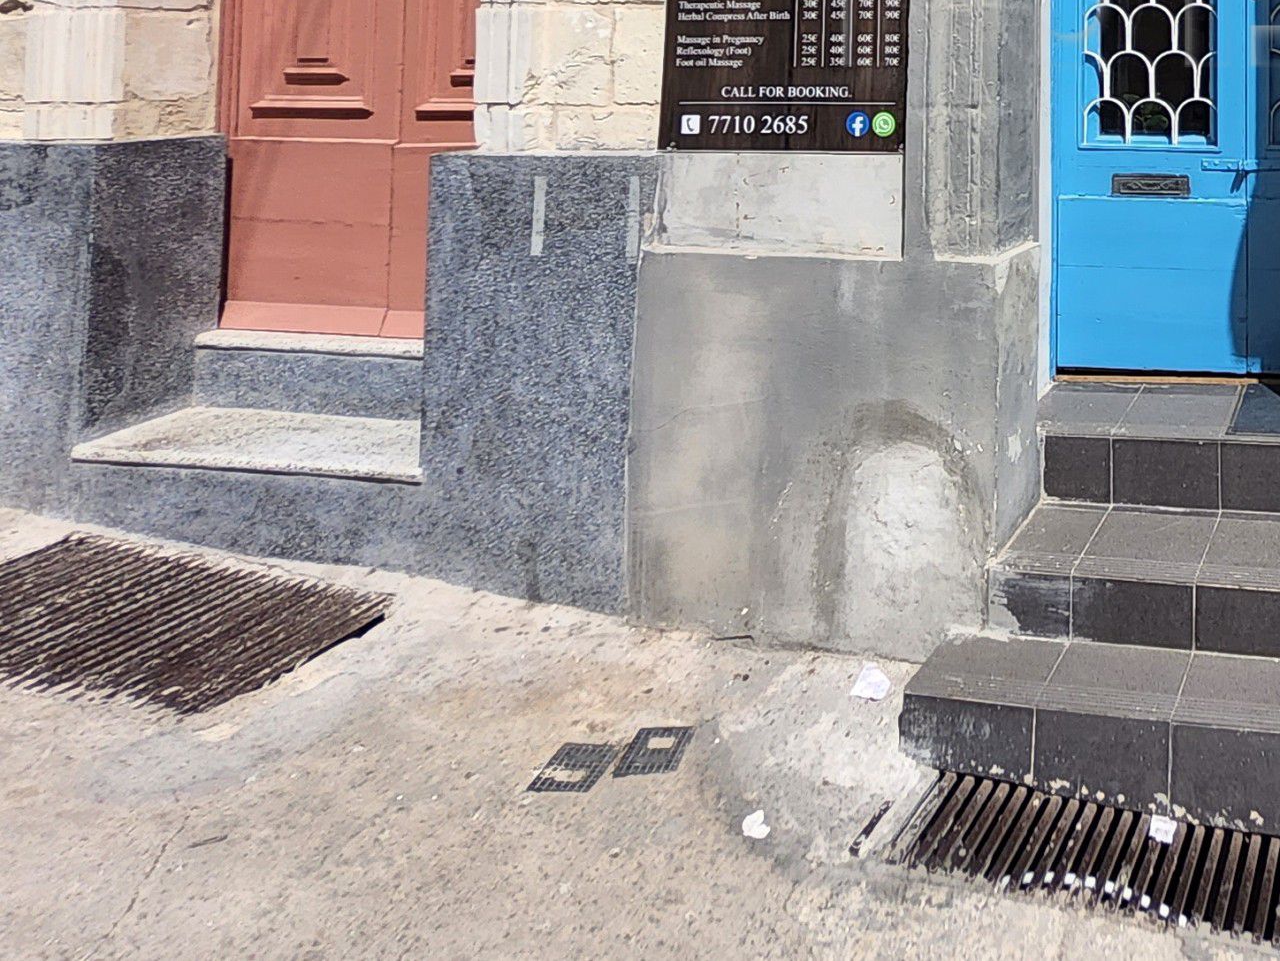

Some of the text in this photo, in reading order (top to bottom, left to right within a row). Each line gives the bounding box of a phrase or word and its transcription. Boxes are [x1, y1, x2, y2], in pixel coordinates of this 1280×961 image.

[678, 0, 724, 10] Therapeutic
[726, 0, 761, 10] Massage
[678, 12, 704, 21] Herbal
[706, 12, 745, 22] Compress
[746, 11, 768, 20] After
[769, 11, 790, 20] Birth
[677, 35, 711, 45] Massage
[712, 35, 720, 44] in
[722, 35, 764, 45] Pregnancy
[676, 46, 724, 56] Reflexology
[726, 46, 752, 56] (Foot)
[676, 58, 694, 67] Foot
[708, 58, 743, 68] Massage
[721, 86, 852, 98] CALL FOR BOOKING.
[708, 115, 755, 134] 7710
[760, 115, 809, 134] 2685
